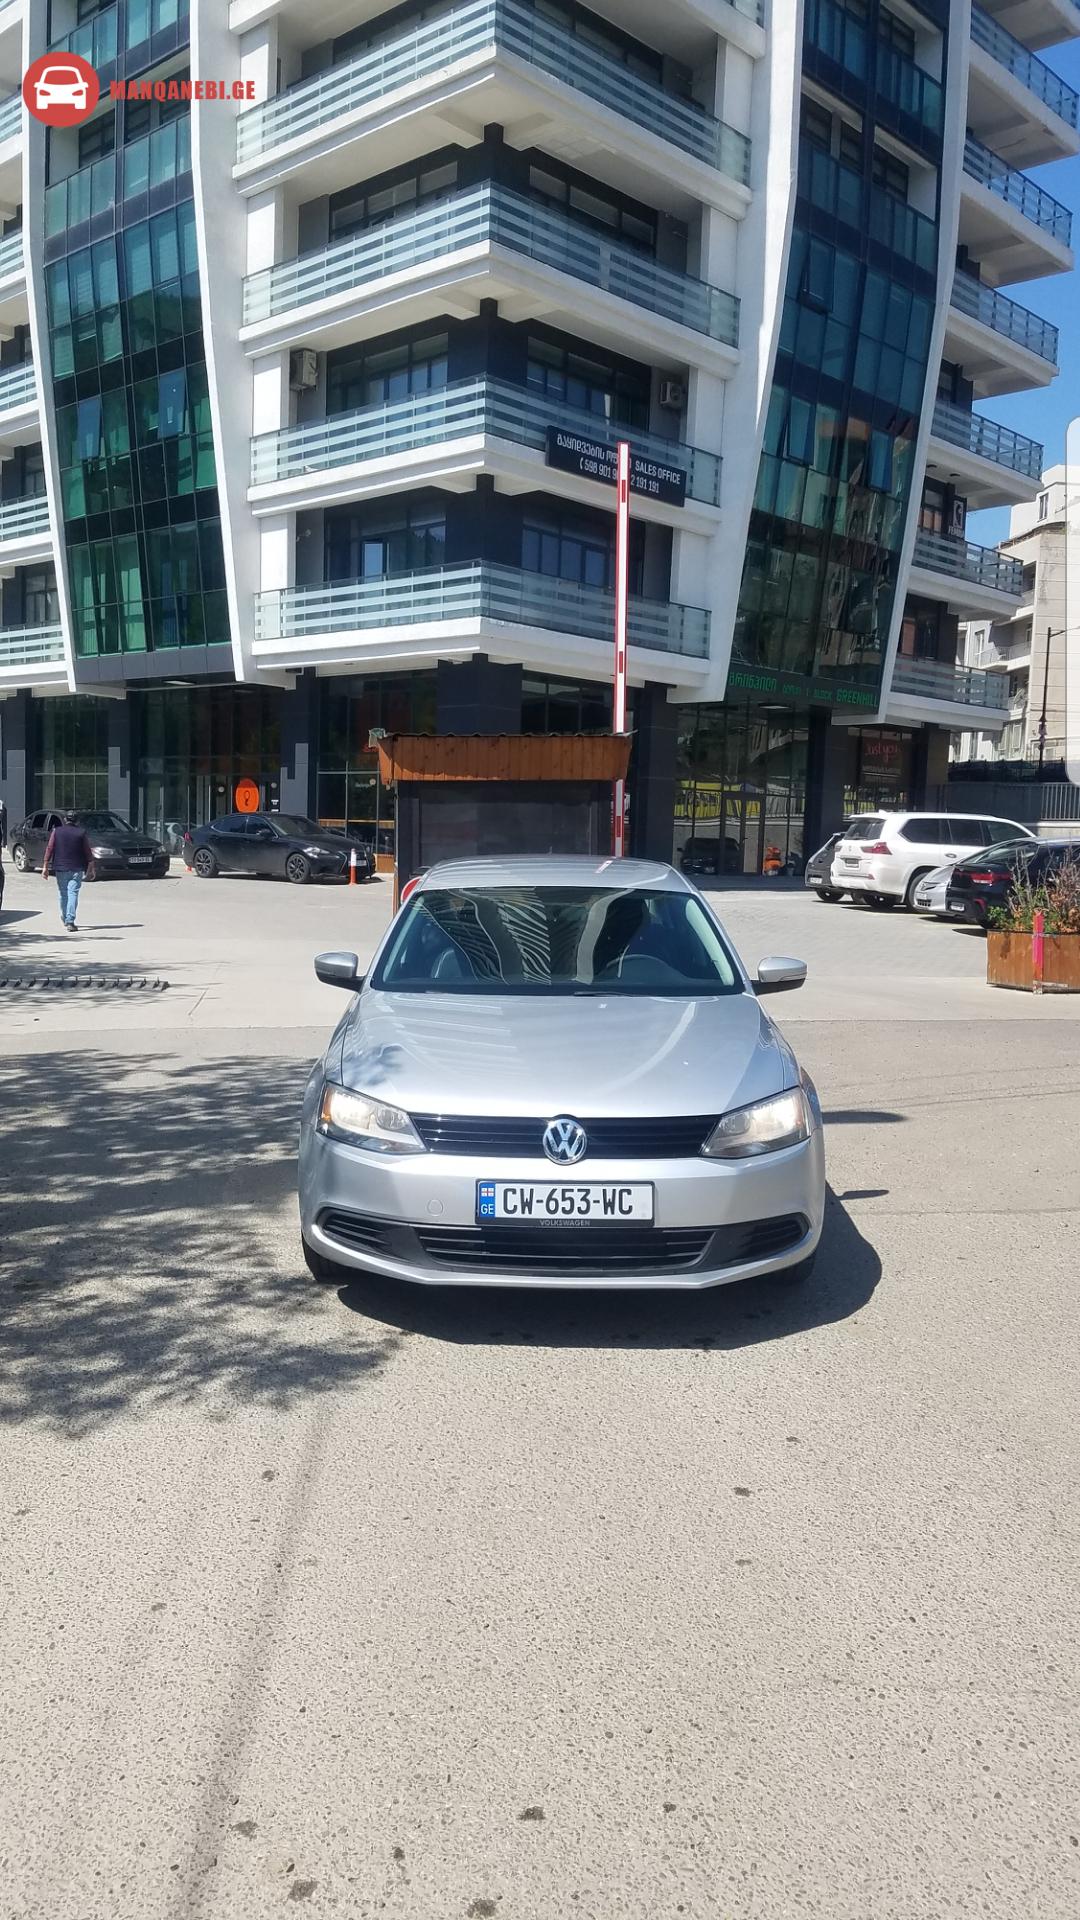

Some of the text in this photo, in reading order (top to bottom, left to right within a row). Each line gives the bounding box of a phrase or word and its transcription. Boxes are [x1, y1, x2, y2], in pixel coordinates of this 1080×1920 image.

[584, 459, 598, 474] 598
[598, 464, 611, 478] 901
[636, 476, 648, 490] 191
[648, 480, 660, 494] 191
[635, 460, 657, 478] SALES
[657, 468, 681, 485] OFFICE
[836, 688, 878, 707] GREENHILL
[480, 1203, 495, 1215] GE
[502, 1188, 633, 1215] CW-653-WC
